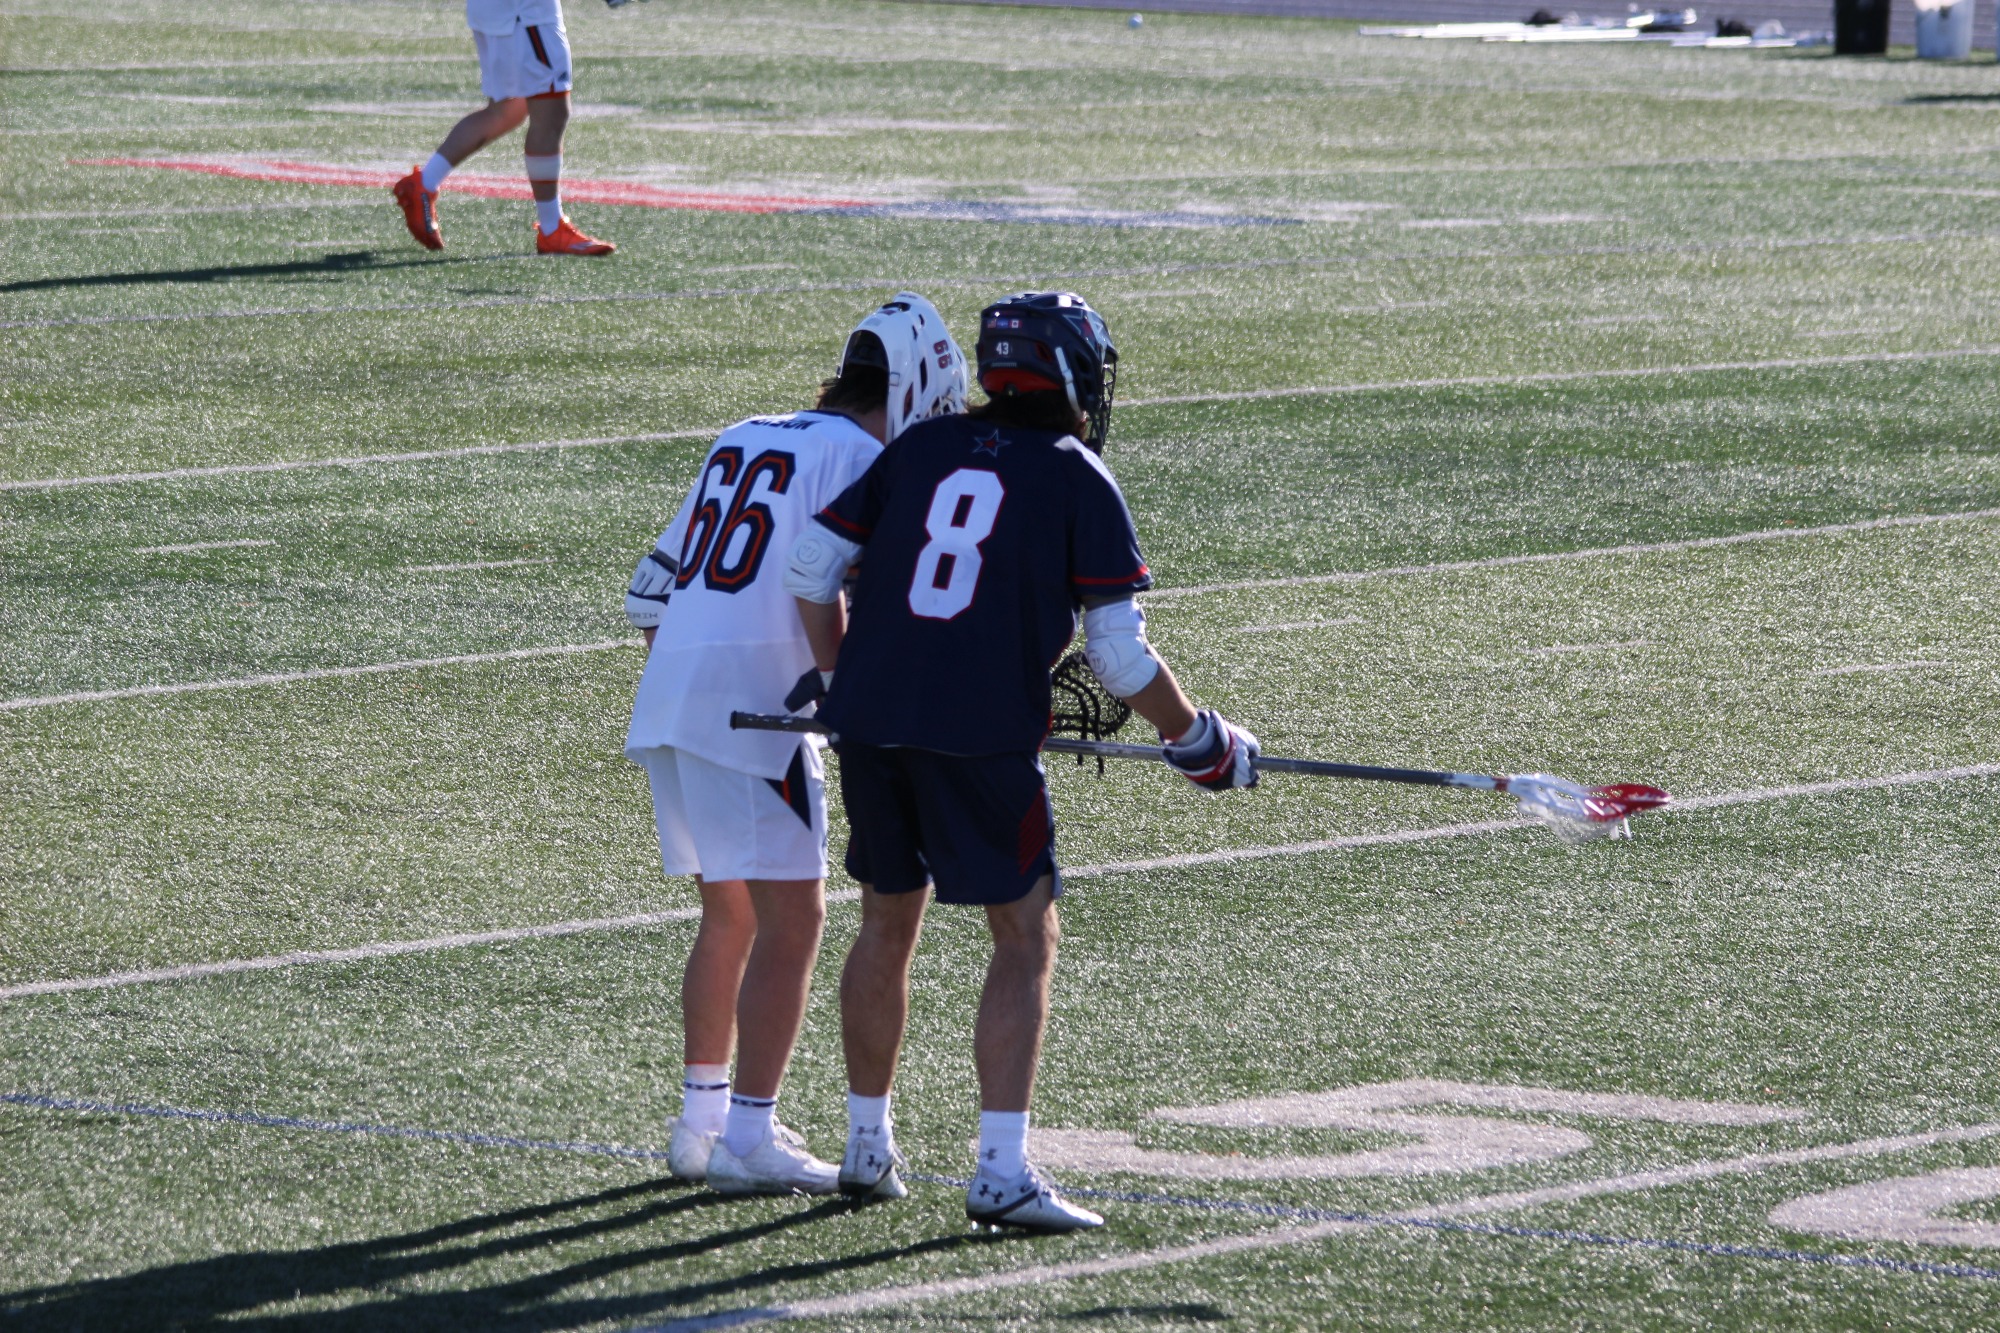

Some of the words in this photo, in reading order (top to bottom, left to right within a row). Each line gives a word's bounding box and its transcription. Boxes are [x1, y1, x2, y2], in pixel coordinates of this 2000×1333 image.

[933, 339, 953, 369] 66
[995, 341, 1009, 355] 43
[675, 446, 796, 594] 66
[908, 468, 1006, 621] 8
